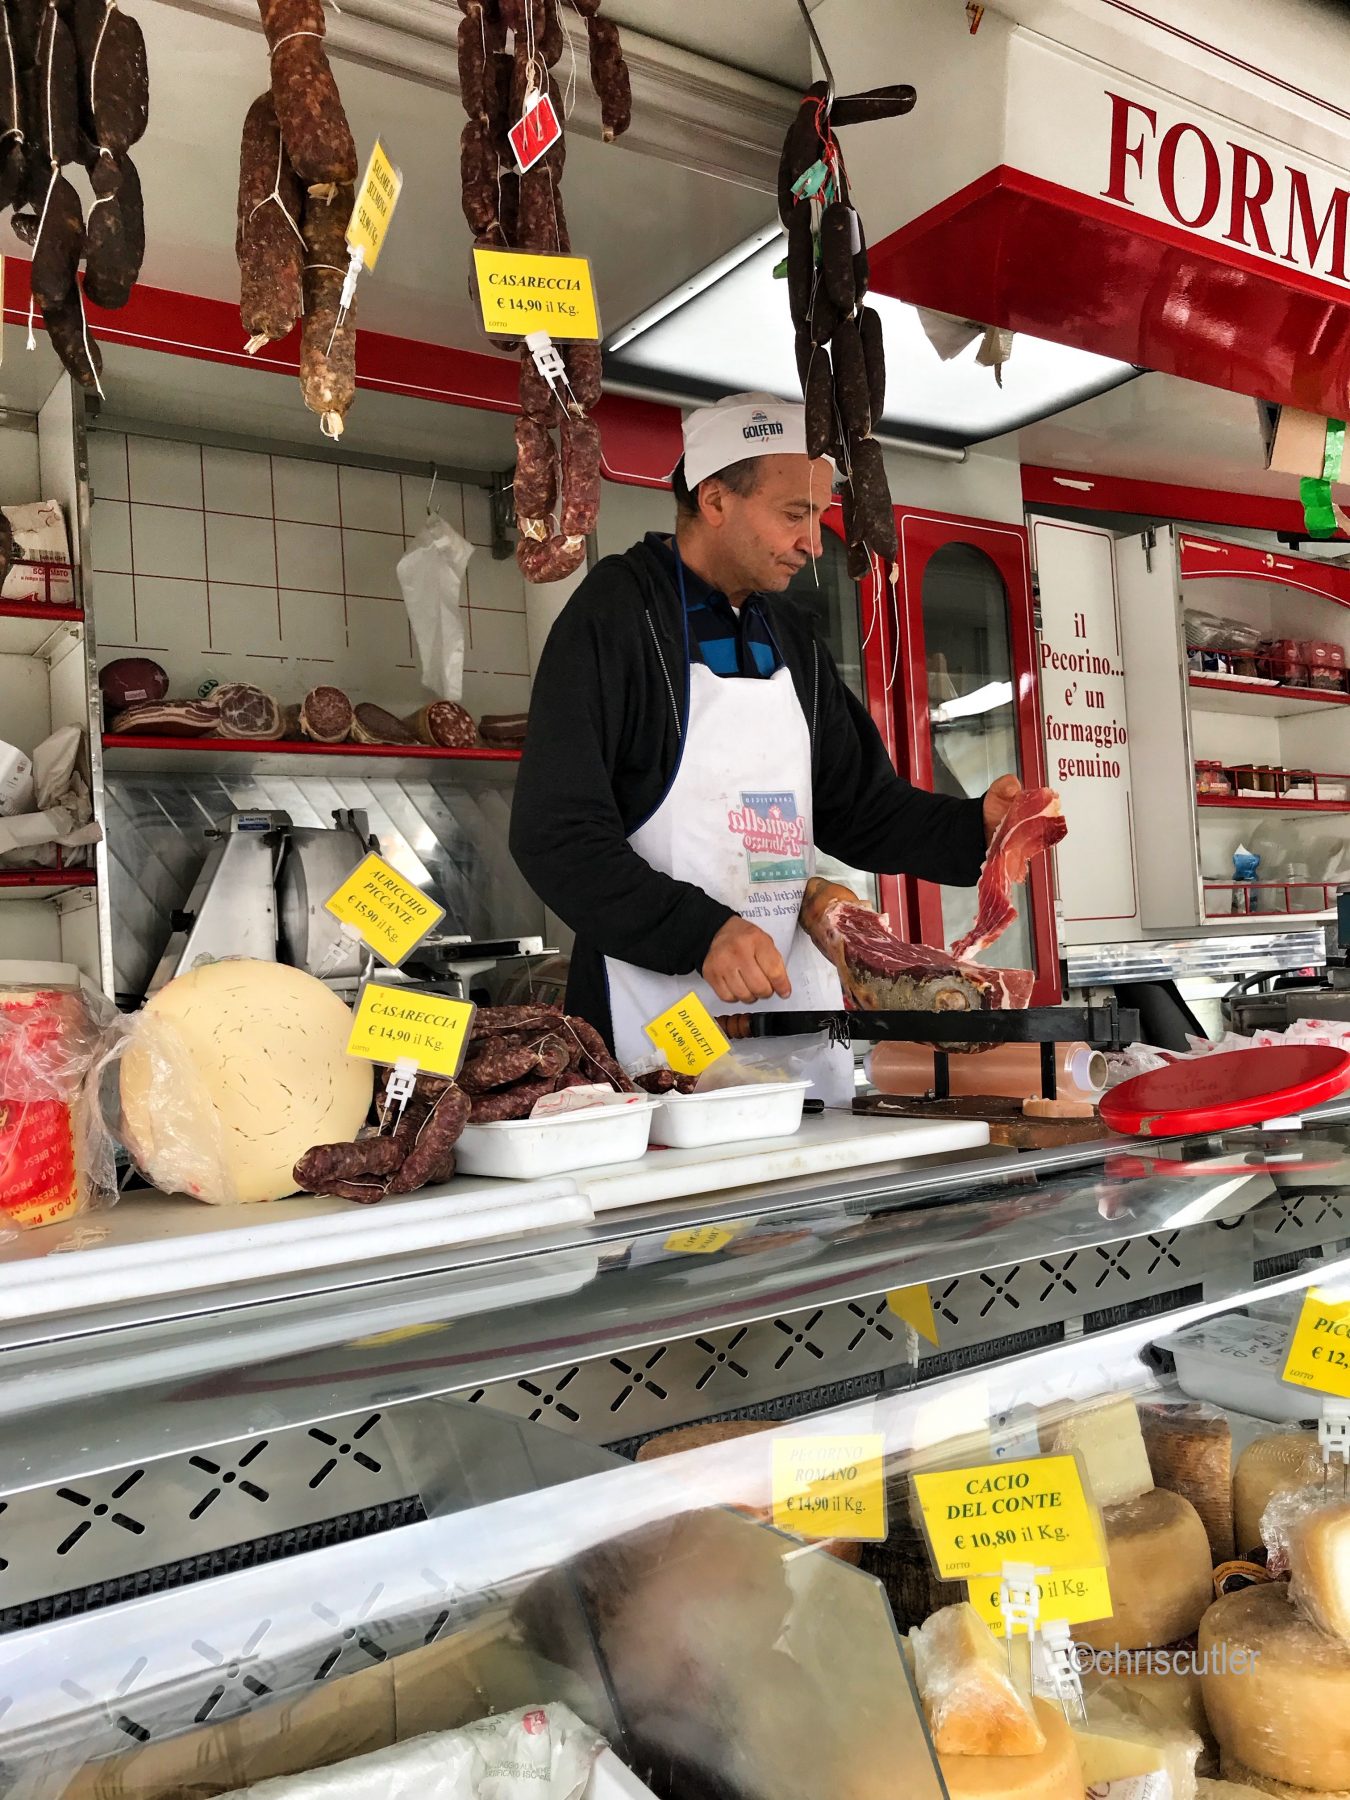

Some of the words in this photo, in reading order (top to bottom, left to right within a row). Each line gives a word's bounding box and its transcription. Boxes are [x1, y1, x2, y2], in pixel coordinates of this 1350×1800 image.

[488, 273, 581, 291] CASARECCIA
[497, 297, 506, 309] €
[509, 298, 542, 312] 14,90
[545, 300, 554, 313] il
[557, 302, 580, 317] Kg.
[742, 423, 783, 439] GOLFETTA
[1074, 612, 1087, 638] il
[1041, 643, 1124, 677] Pecorino...
[1085, 690, 1105, 708] un
[1046, 714, 1127, 748] formaggio
[1058, 752, 1120, 781] genuino
[363, 882, 415, 925] PICCANTE
[370, 871, 428, 916] AURICCHIO
[348, 895, 357, 903] €
[354, 900, 379, 922] 15,90
[376, 919, 387, 930] il
[384, 925, 398, 943] Kg.
[370, 1003, 457, 1029] CASARECCIA
[368, 1025, 377, 1035] €
[380, 1027, 411, 1042] 14,90
[413, 1034, 422, 1044] il
[425, 1036, 444, 1051] Kg.
[677, 1010, 715, 1057] DIAVOLETTI
[1312, 1346, 1323, 1360] €
[1327, 1350, 1350, 1370] 12,
[1289, 1368, 1314, 1380] LOTTO
[790, 1446, 863, 1462] PECORINO
[795, 1466, 858, 1482] ROMANO
[966, 1473, 1030, 1495] CACIO
[787, 1496, 794, 1511] €
[798, 1496, 829, 1514] 14,90
[832, 1496, 841, 1511] il
[844, 1496, 867, 1515] Kg.
[947, 1501, 988, 1520] DEL
[992, 1491, 1063, 1514] CONTE
[954, 1535, 967, 1550] €
[970, 1529, 1018, 1549] 10,80
[1021, 1526, 1034, 1543] il
[1037, 1523, 1071, 1542] Kg.
[945, 1561, 972, 1571] LOTTO
[990, 1591, 1001, 1608] €
[1048, 1581, 1059, 1598] il
[1062, 1578, 1090, 1597] Kg.
